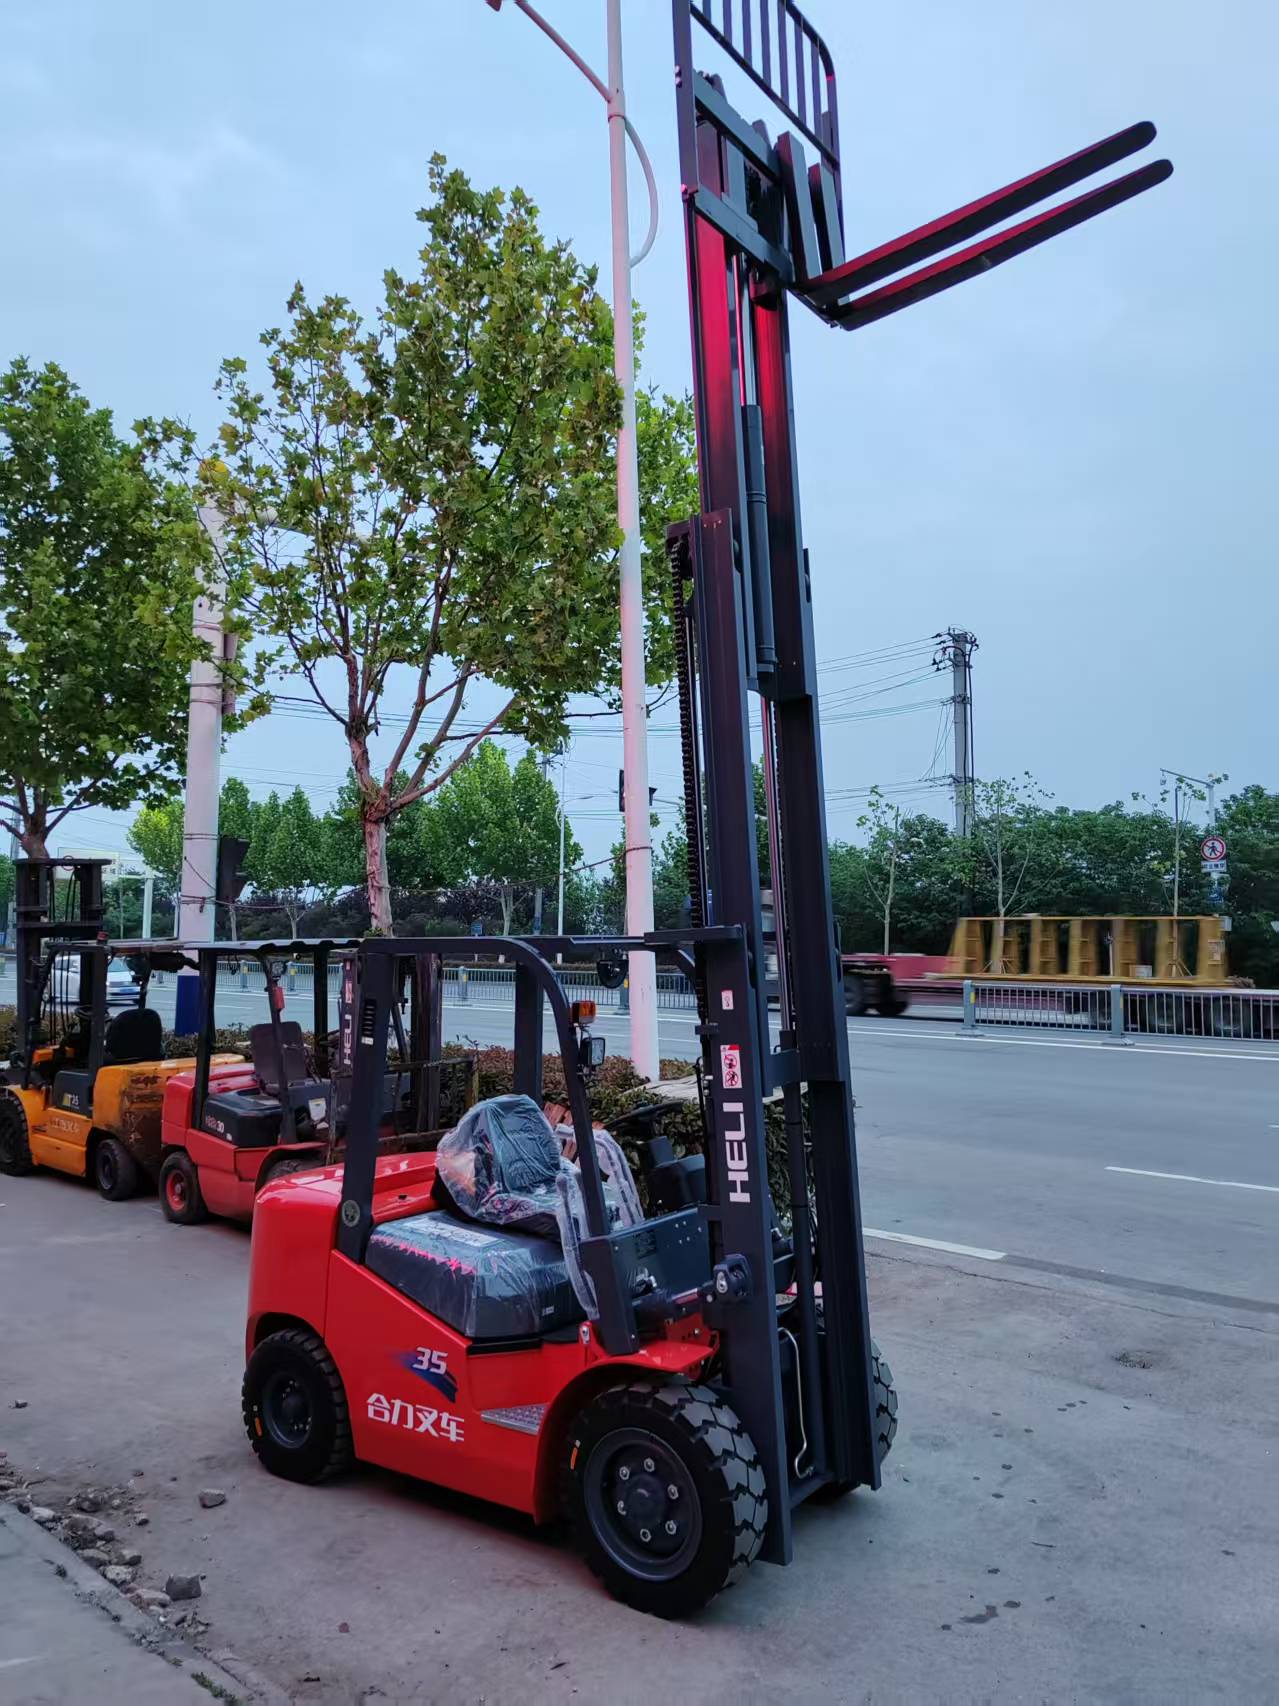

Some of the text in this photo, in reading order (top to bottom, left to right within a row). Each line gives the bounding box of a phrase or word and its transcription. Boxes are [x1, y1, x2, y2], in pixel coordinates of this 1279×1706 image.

[722, 1102, 751, 1202] HELI
[412, 1346, 448, 1375] 35
[366, 1392, 465, 1442] 合力叉车
